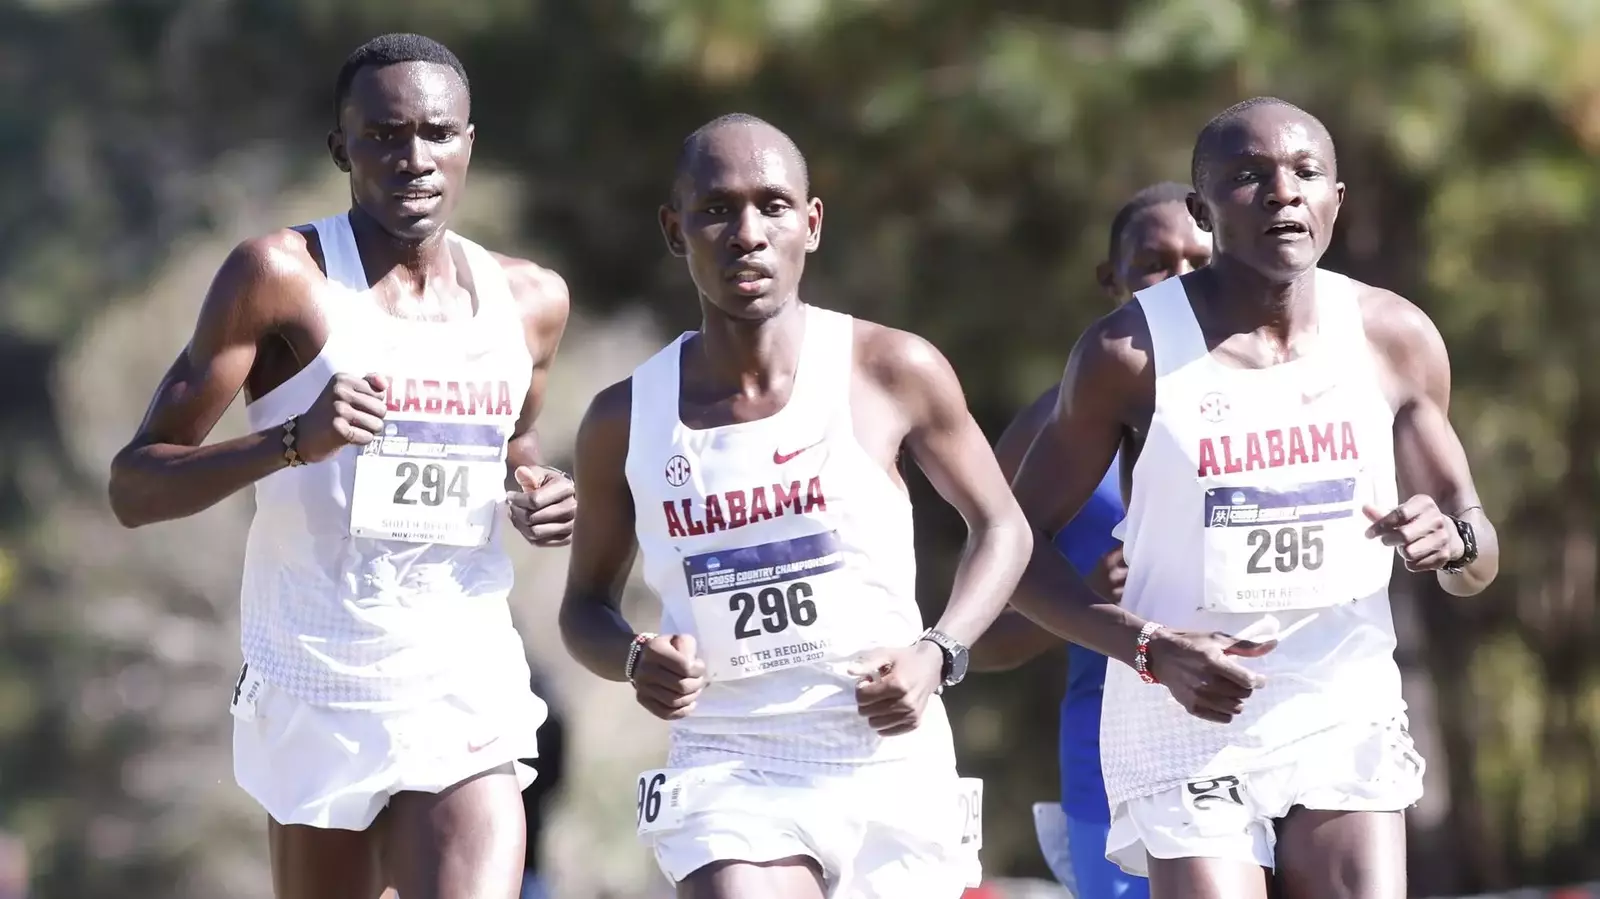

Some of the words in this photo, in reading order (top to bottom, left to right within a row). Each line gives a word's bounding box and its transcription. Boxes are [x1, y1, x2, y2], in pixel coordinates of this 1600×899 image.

[384, 374, 513, 416] LABAMA
[1197, 421, 1359, 478] ALABAMA
[392, 461, 471, 508] 294
[666, 455, 691, 487] SEC
[662, 475, 827, 538] ALABAMA
[1246, 524, 1324, 575] 295
[708, 573, 736, 587] CROSS
[736, 567, 775, 582] COUNTRY
[1235, 588, 1276, 600] SOUTH
[728, 581, 818, 641] 296
[729, 649, 772, 667] SOUTH
[806, 651, 825, 662] 2017
